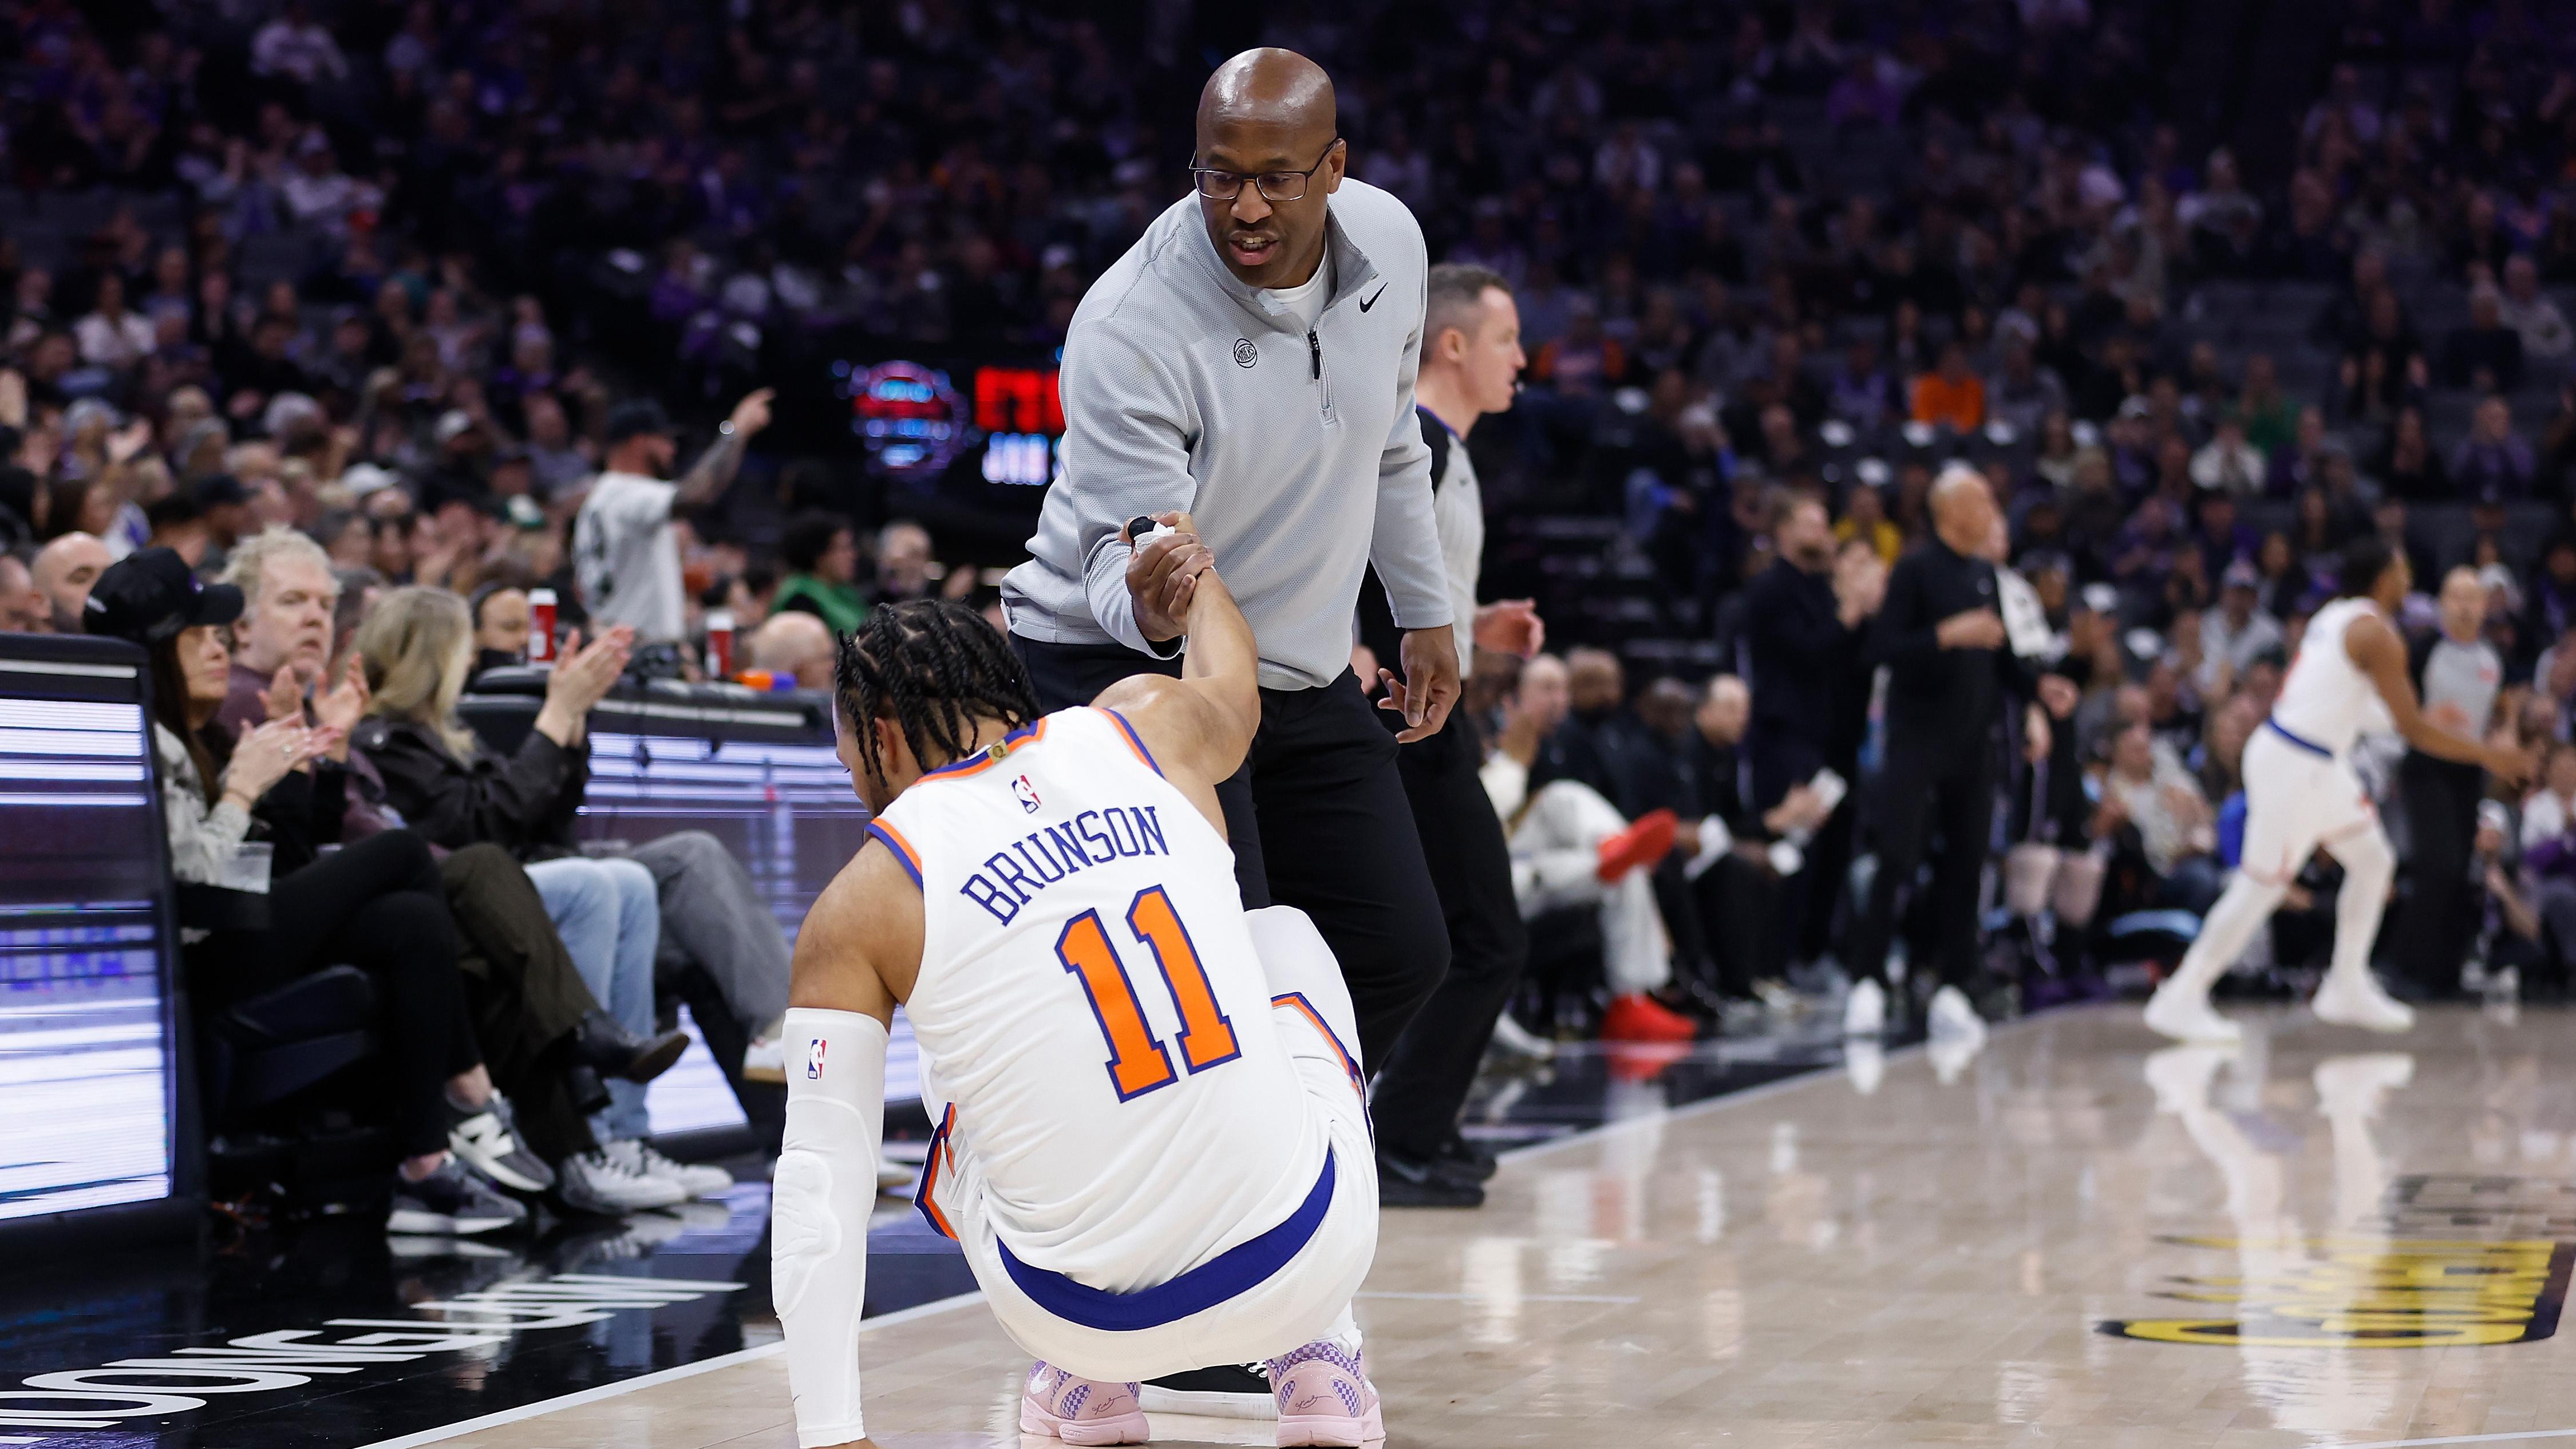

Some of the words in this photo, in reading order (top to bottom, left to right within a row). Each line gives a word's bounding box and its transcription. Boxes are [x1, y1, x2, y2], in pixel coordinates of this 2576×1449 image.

[1236, 345, 1254, 362] KNICKS
[961, 806, 1170, 927] BRUNSON
[1054, 884, 1242, 1104] 11
